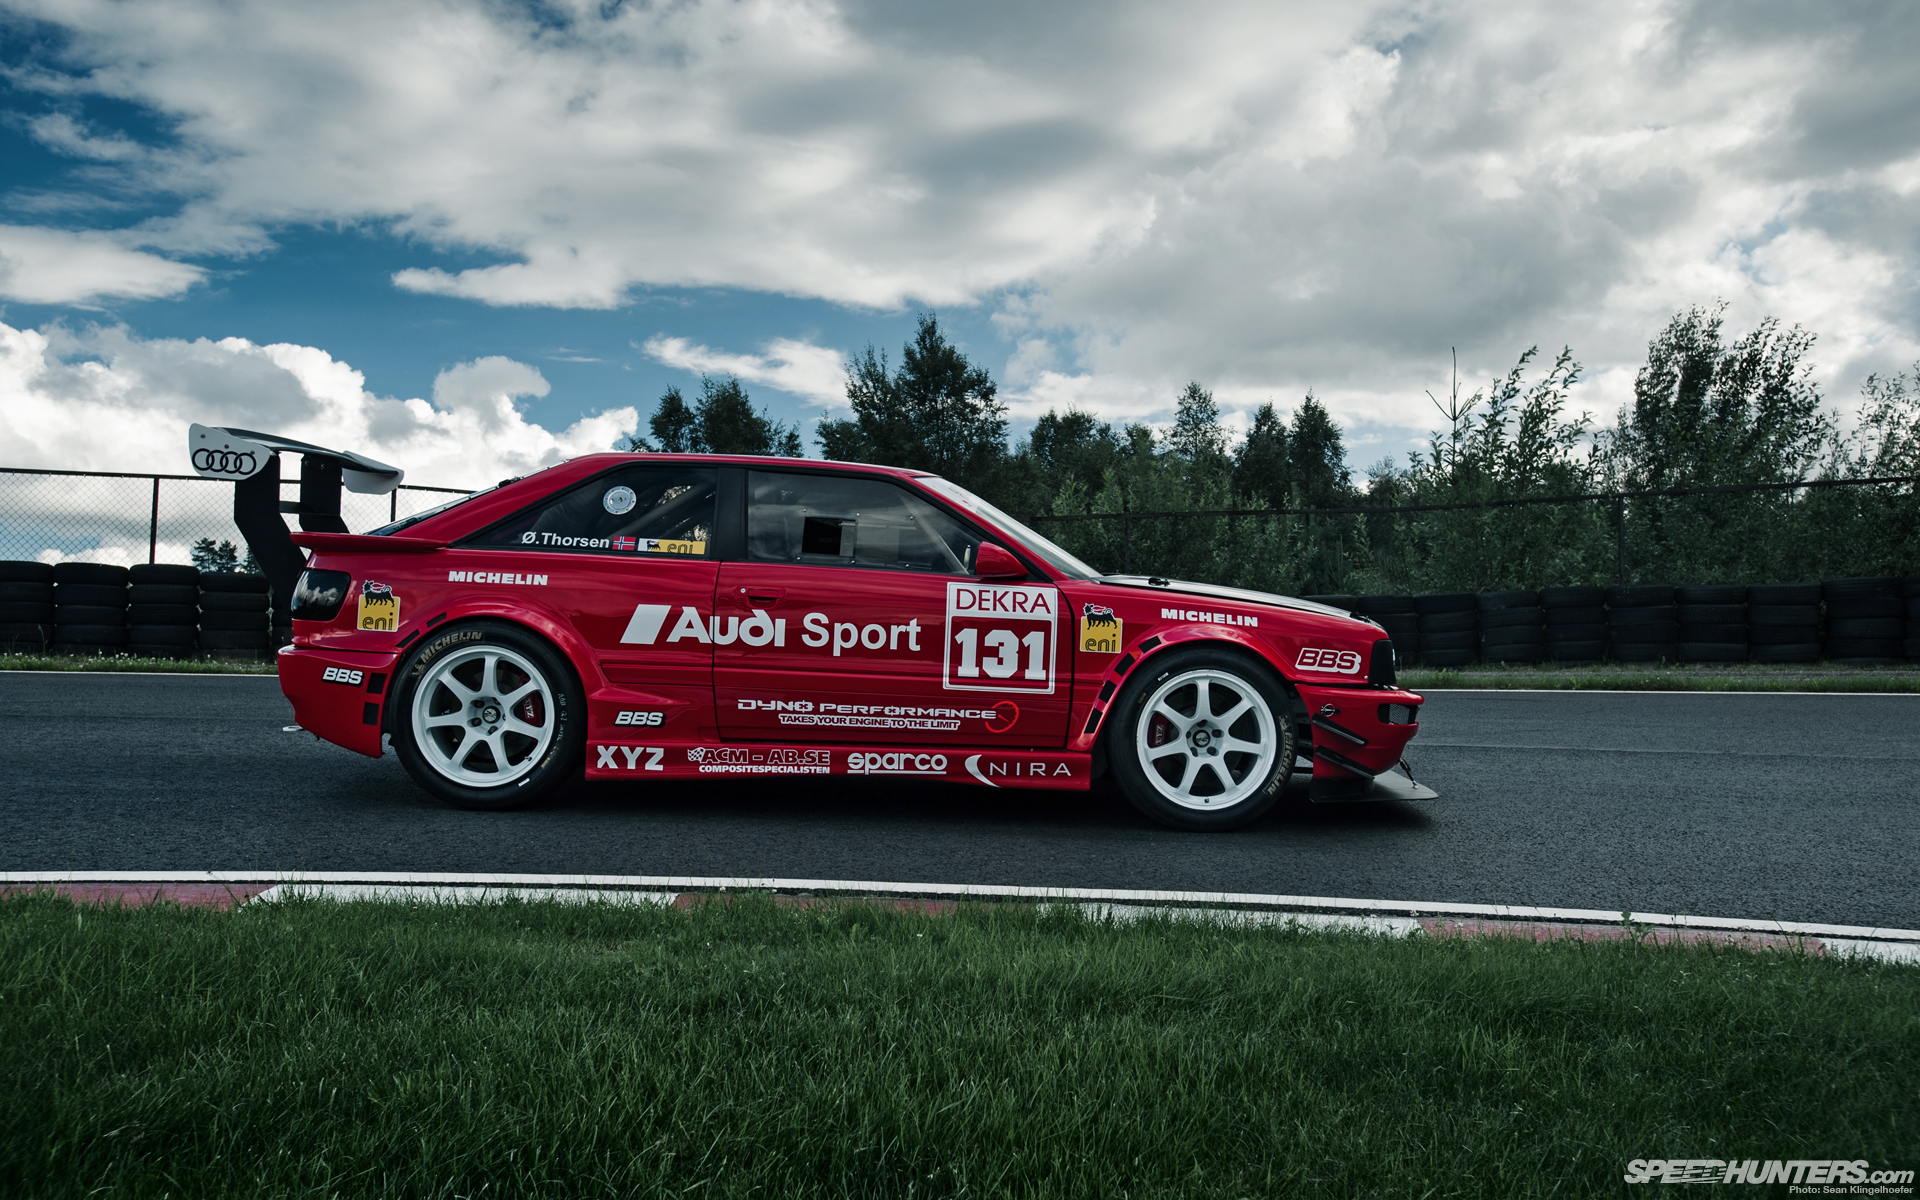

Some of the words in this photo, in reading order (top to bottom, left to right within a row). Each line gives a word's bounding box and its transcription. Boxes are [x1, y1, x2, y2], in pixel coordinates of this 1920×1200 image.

[521, 531, 610, 548] Ø.Thorsen
[667, 540, 693, 554] eni
[448, 571, 549, 586] MICHELIN
[956, 588, 1051, 614] DEKRA
[362, 612, 393, 631] eni
[1161, 608, 1258, 627] MICHELIN
[666, 606, 786, 647] Audi
[801, 612, 921, 657] Sport
[420, 631, 482, 663] MICHELIN
[1085, 633, 1116, 652] eni
[954, 628, 1047, 680] 131
[1296, 648, 1359, 672] BBS
[322, 667, 363, 684] BBS
[614, 711, 664, 726] BBS
[738, 699, 814, 713] DYNO
[820, 703, 997, 719] PERFORMANCE
[779, 714, 815, 725] TAKES
[816, 715, 848, 726] YOUR
[849, 716, 889, 727] ENGINE
[890, 717, 906, 728] TO
[906, 718, 929, 729] THE
[930, 719, 960, 730] LIMIT
[597, 745, 664, 771] XYZ
[700, 748, 749, 764] ACM
[767, 749, 831, 765] AB.SE
[847, 752, 948, 776] sparco
[1267, 731, 1293, 796] MICHELIN
[699, 765, 831, 774] COMPOSITESPECIALISTEN
[989, 762, 1072, 777] NIRA
